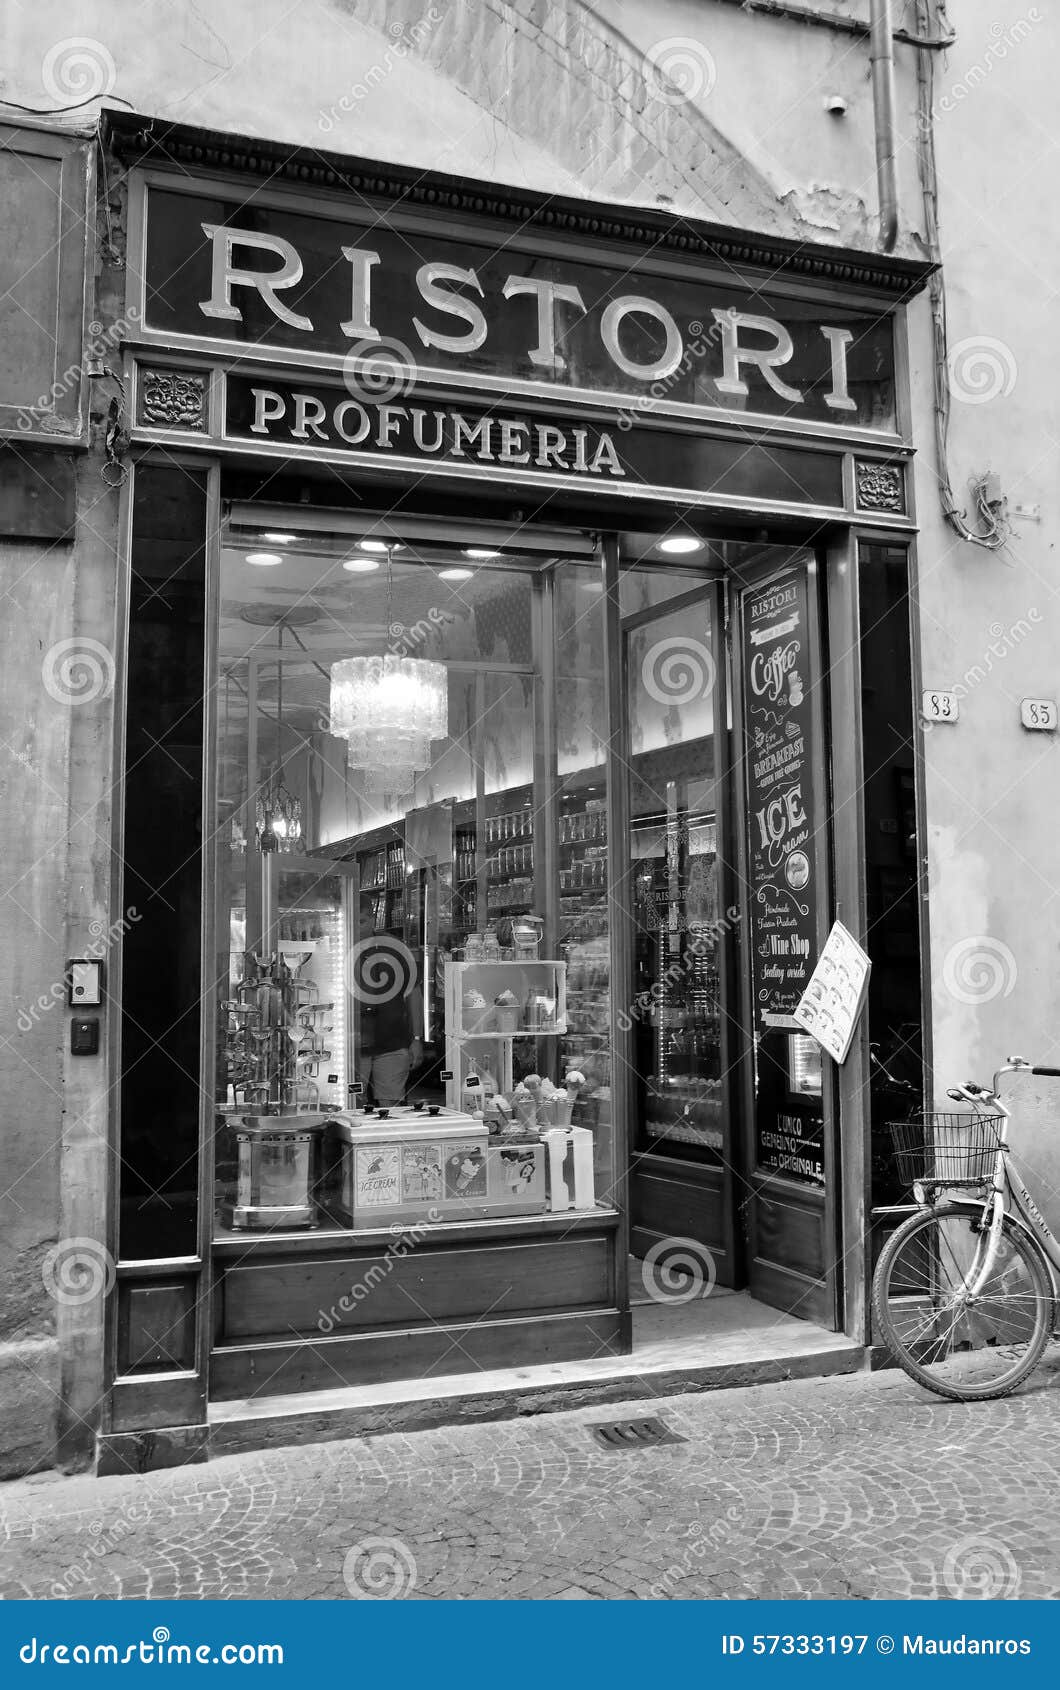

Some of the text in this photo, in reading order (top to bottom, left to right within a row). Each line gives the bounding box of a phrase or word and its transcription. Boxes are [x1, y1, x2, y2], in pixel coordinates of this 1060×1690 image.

[199, 223, 858, 411] RISTORI
[250, 388, 626, 476] PROFUMERIA
[751, 586, 798, 618] RISTORI
[931, 694, 951, 717] 83
[1030, 703, 1051, 724] 85
[754, 737, 804, 779] BREAKFAST
[755, 783, 808, 850] ICE
[770, 933, 810, 959] Wine Shop
